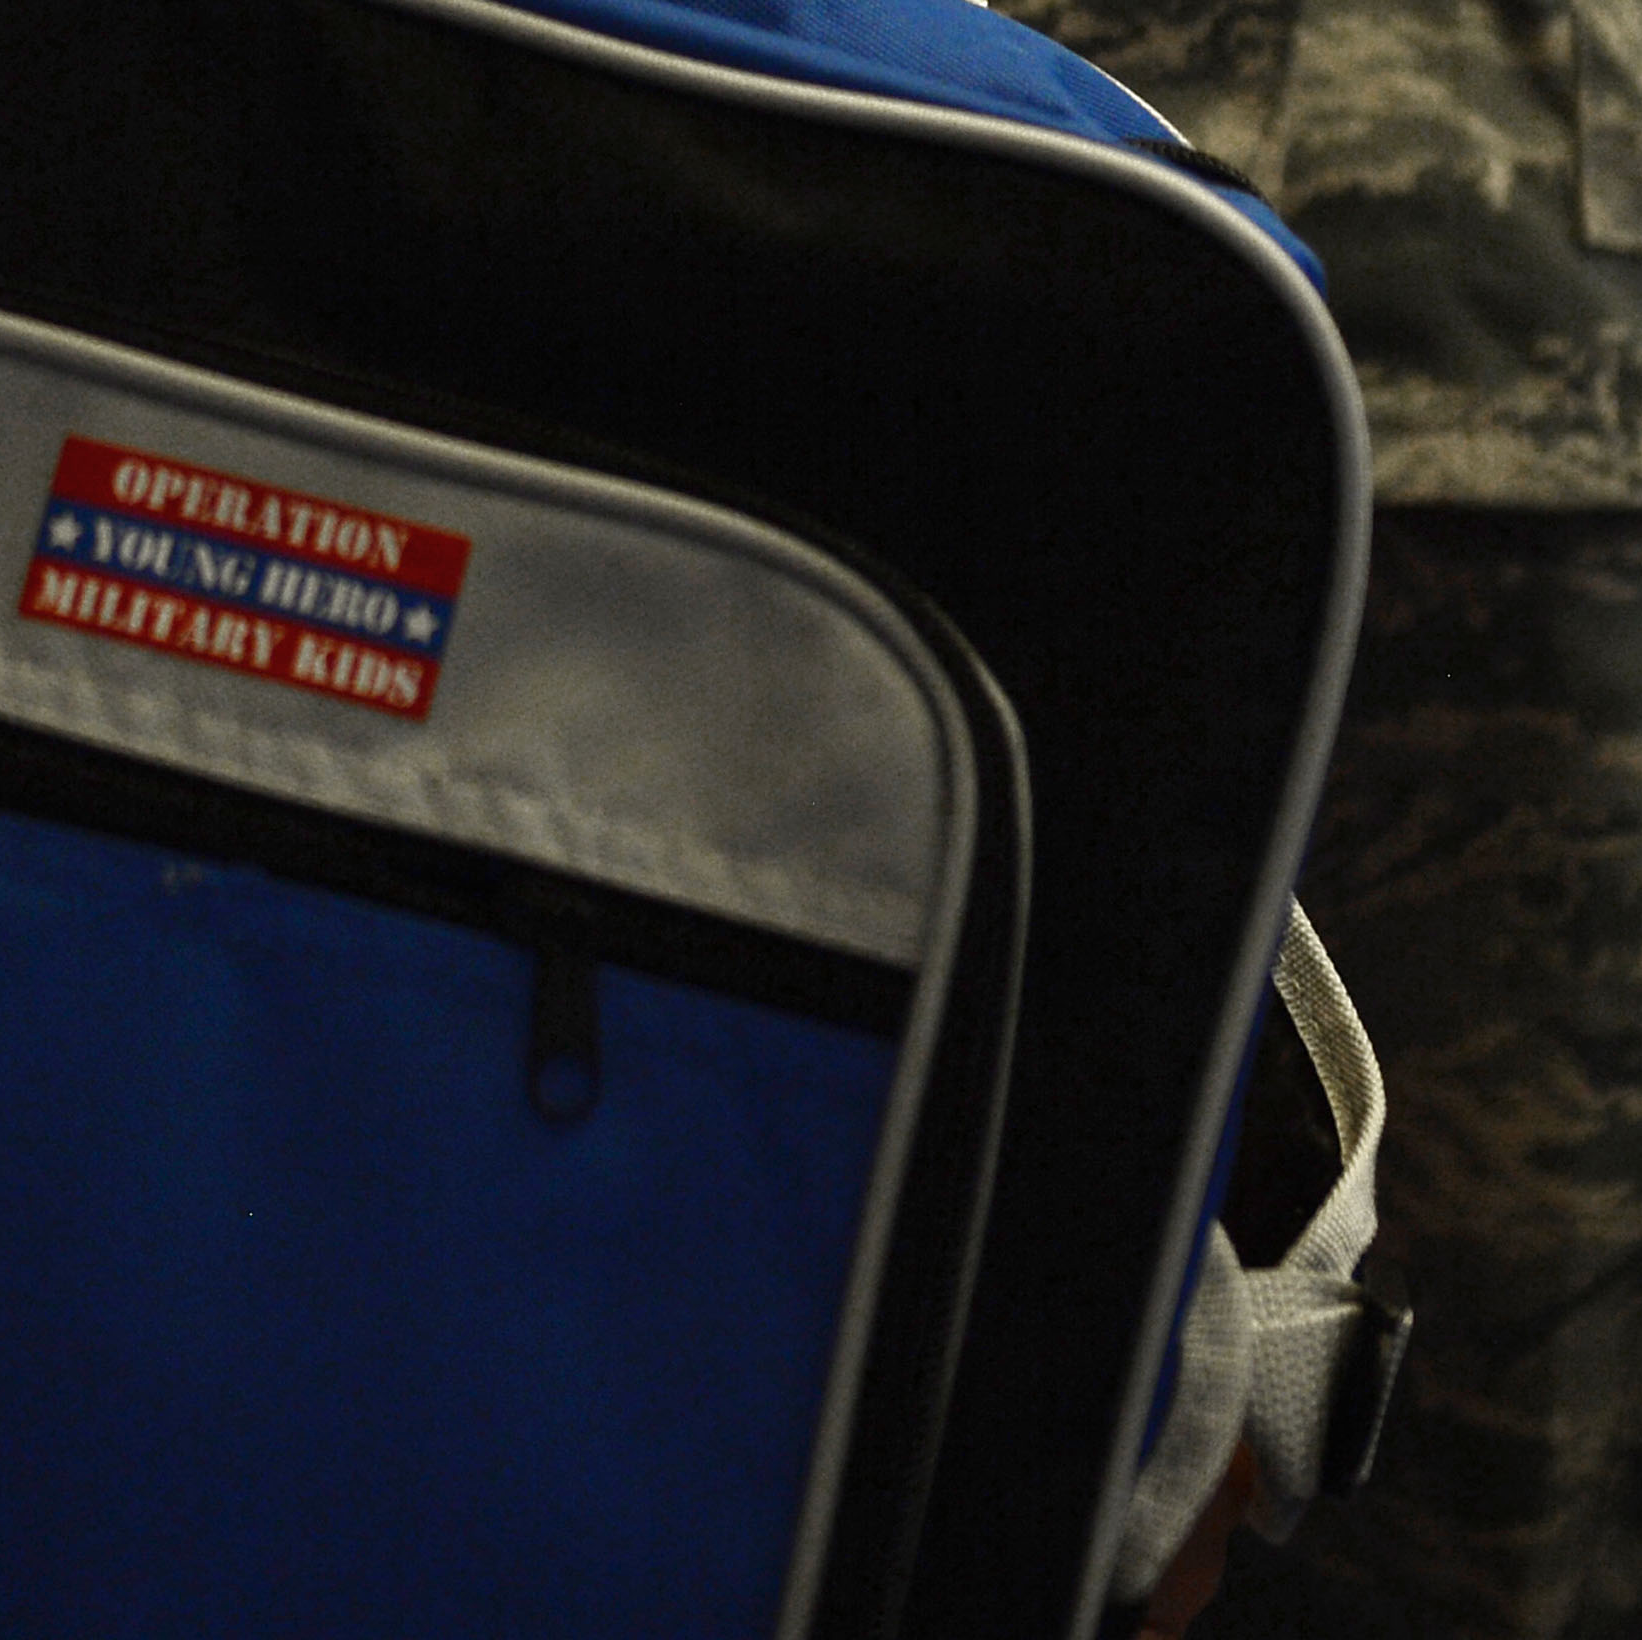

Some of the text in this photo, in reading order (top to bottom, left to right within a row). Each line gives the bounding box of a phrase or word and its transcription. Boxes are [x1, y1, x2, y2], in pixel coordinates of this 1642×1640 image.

[112, 459, 408, 571] OPERATION
[92, 516, 399, 635] YOUNG HERO
[37, 569, 423, 708] MILITARY KIDS
